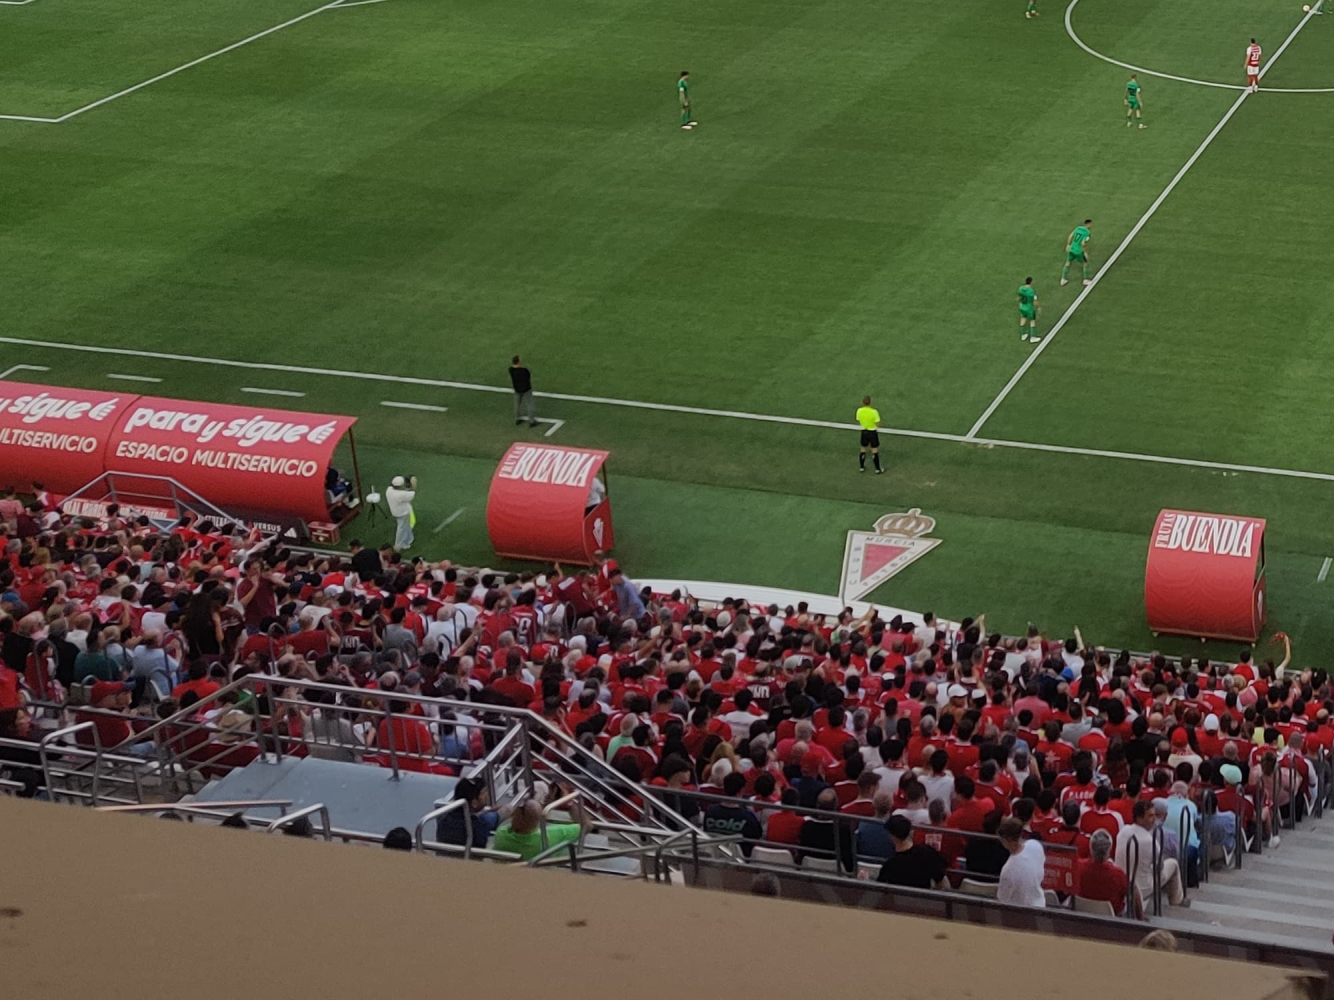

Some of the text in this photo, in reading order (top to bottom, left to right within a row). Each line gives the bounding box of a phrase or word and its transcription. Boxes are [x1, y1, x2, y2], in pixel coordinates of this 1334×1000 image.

[8, 392, 92, 424] sigue
[0, 427, 97, 454] LTISERVICIO
[123, 407, 309, 447] para y sigue
[116, 440, 318, 478] ESPACIO MULTISERVICIO
[865, 536, 915, 547] MURCIA
[1154, 512, 1177, 549] FRUTAS
[1167, 514, 1254, 558] BUENDIA
[848, 546, 862, 586] CLUB
